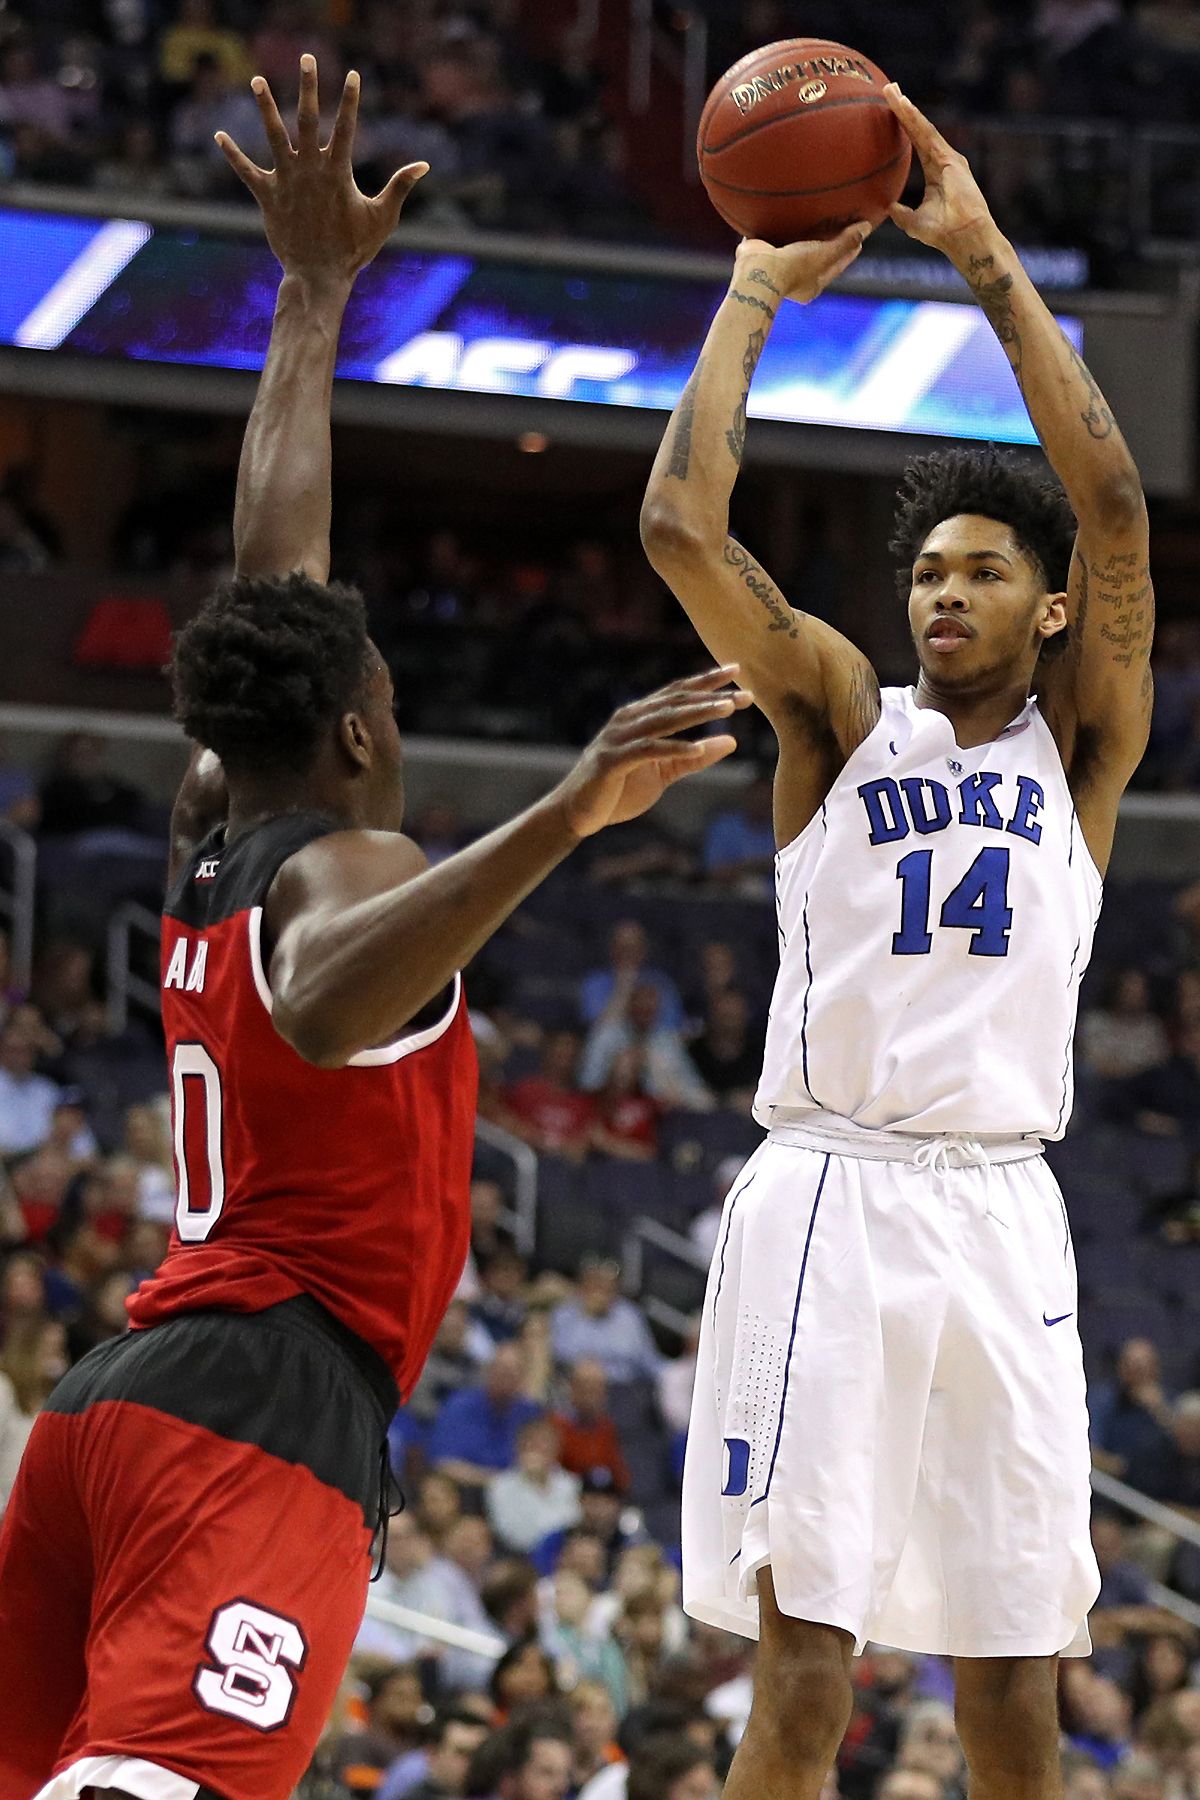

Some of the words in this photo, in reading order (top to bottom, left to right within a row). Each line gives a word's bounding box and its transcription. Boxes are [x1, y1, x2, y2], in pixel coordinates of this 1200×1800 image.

[857, 771, 1045, 846] DUKE
[891, 846, 1014, 957] 14
[173, 1040, 225, 1244] 0
